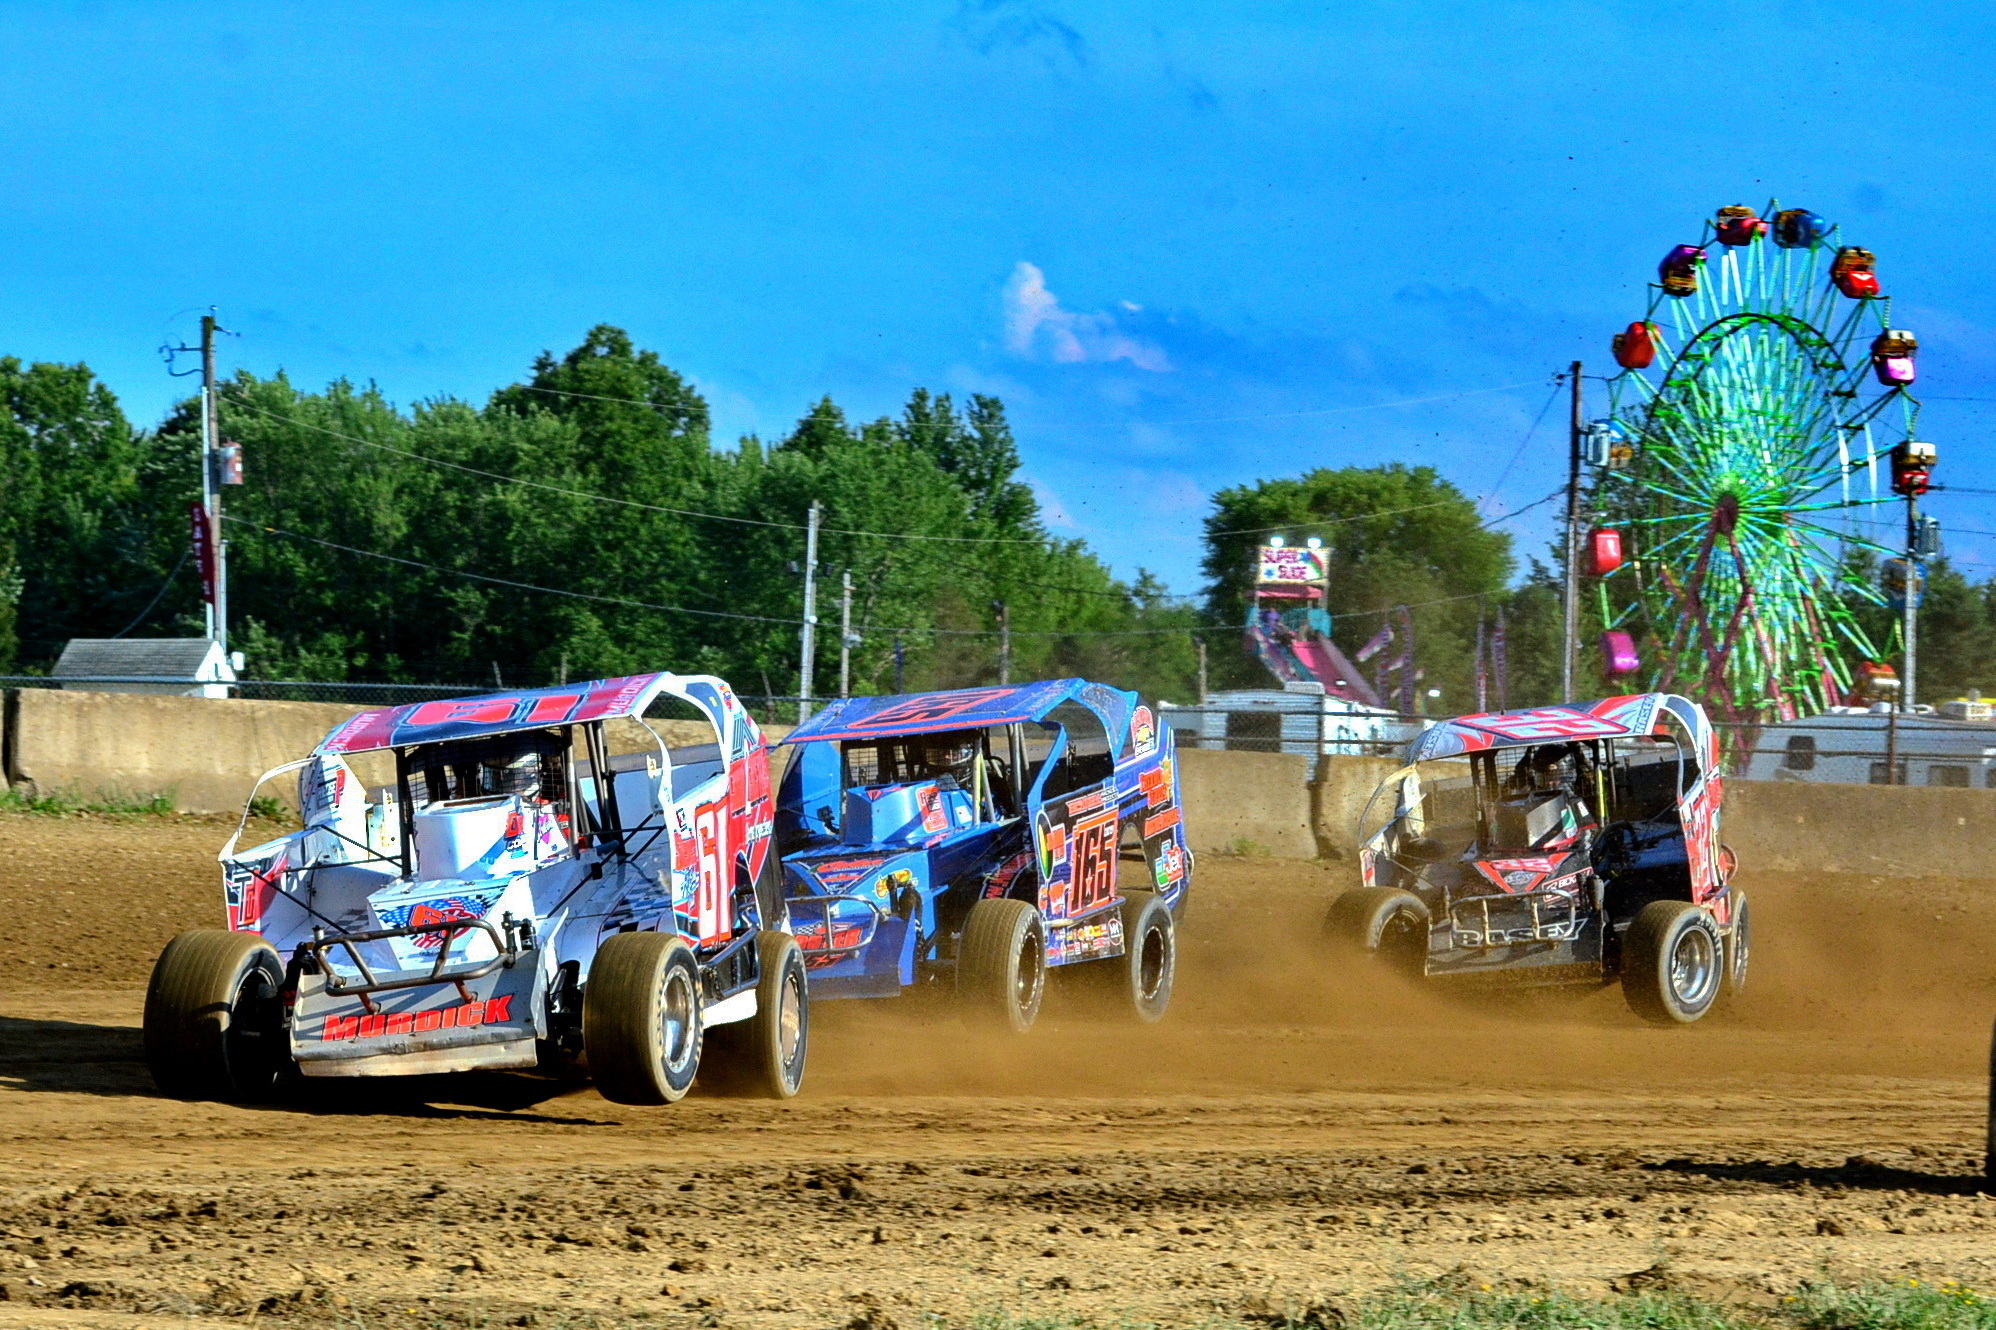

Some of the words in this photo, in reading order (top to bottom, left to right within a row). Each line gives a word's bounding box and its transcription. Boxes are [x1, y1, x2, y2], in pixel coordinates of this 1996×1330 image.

[404, 693, 582, 724] 61
[695, 800, 732, 948] 61
[1068, 818, 1117, 915] 165
[320, 994, 514, 1042] MURDICK
